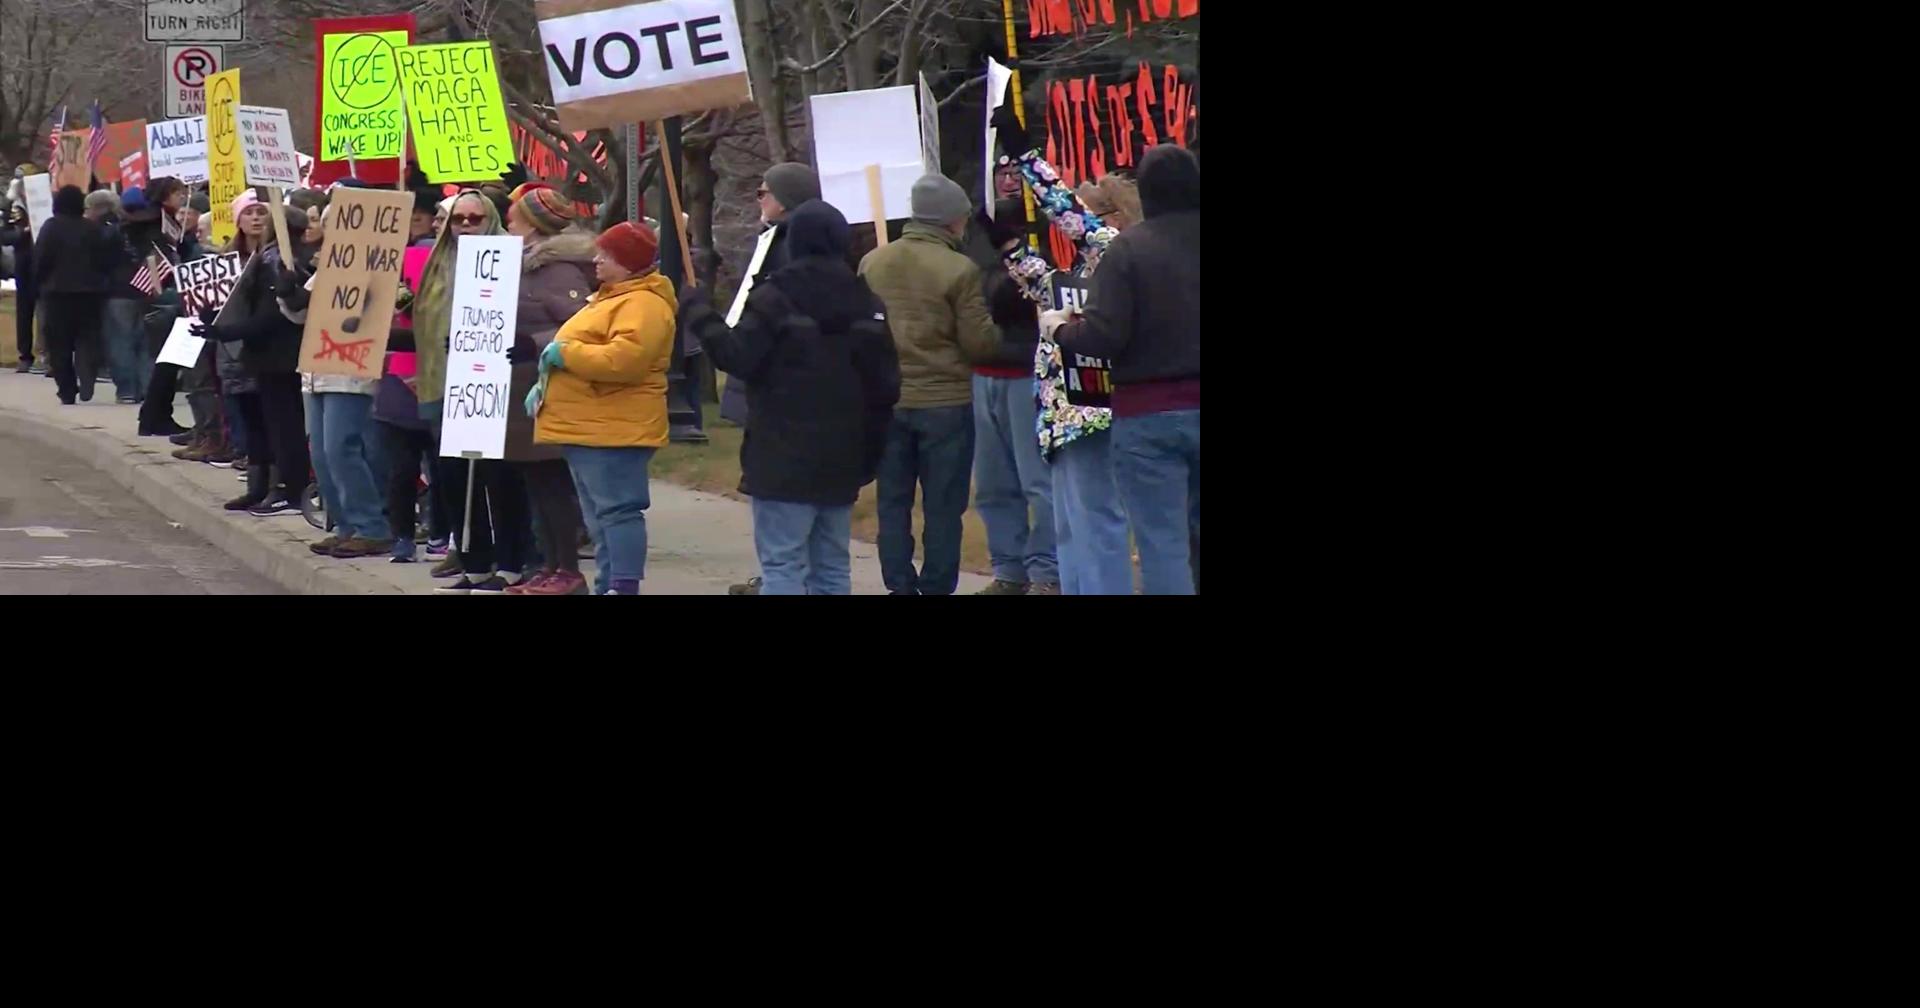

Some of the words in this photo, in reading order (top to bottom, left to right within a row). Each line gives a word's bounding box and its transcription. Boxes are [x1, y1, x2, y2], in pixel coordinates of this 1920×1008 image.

[150, 15, 187, 30] TURN
[196, 15, 239, 30] RIGHT
[400, 46, 491, 78] REJECT
[545, 14, 729, 87] VOTE
[338, 54, 386, 88] ICE
[413, 77, 486, 105] MAGA
[324, 109, 399, 132] CONGRESS
[418, 105, 492, 136] HATE
[151, 121, 193, 151] Abolish
[328, 134, 366, 155] WAKE
[376, 131, 401, 153] UP!
[448, 133, 473, 143] AND
[435, 144, 500, 174] LIES
[336, 202, 364, 230] NO
[373, 205, 402, 234] ICE
[177, 253, 238, 290] RESIST
[327, 243, 355, 269] NO
[365, 245, 399, 272] WAR
[474, 249, 501, 281] ICE
[331, 286, 359, 310] NO
[461, 306, 505, 330] TRUMPS
[454, 330, 503, 353] GESTAPO
[447, 382, 508, 419] FASCISM
